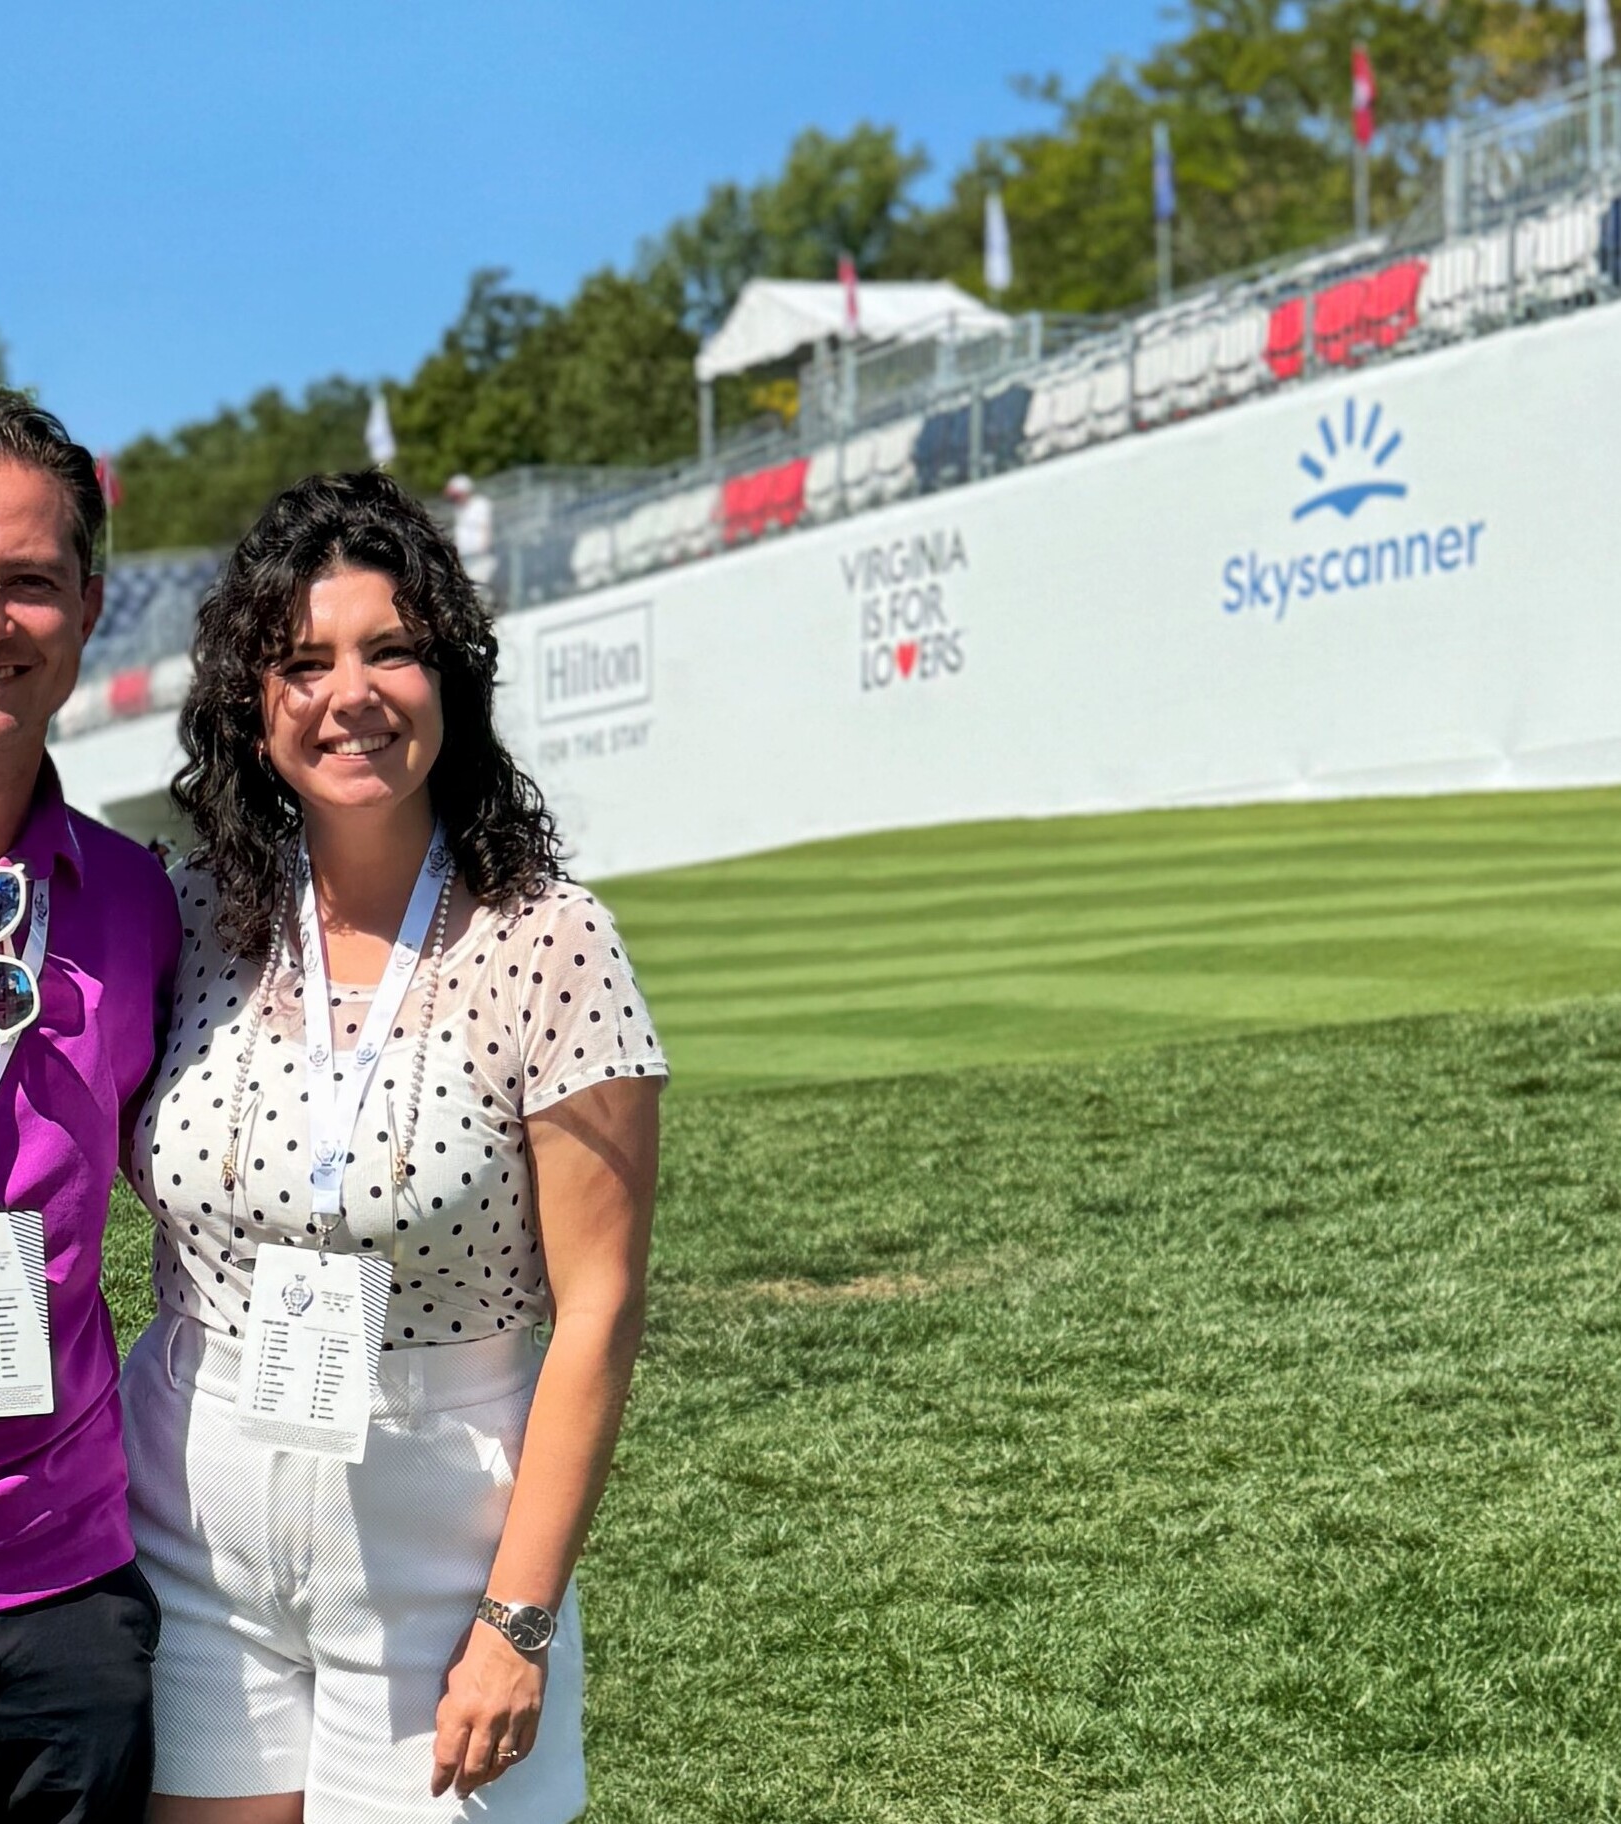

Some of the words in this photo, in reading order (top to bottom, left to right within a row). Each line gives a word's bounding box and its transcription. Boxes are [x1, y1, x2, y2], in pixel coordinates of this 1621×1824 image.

[839, 530, 969, 593] VIRGINIA
[1222, 520, 1484, 622] Skyscanner
[861, 597, 883, 641] IS
[889, 582, 948, 638] FOR
[546, 641, 642, 702] Hilton
[573, 731, 604, 760] THE
[610, 721, 651, 755] STAY
